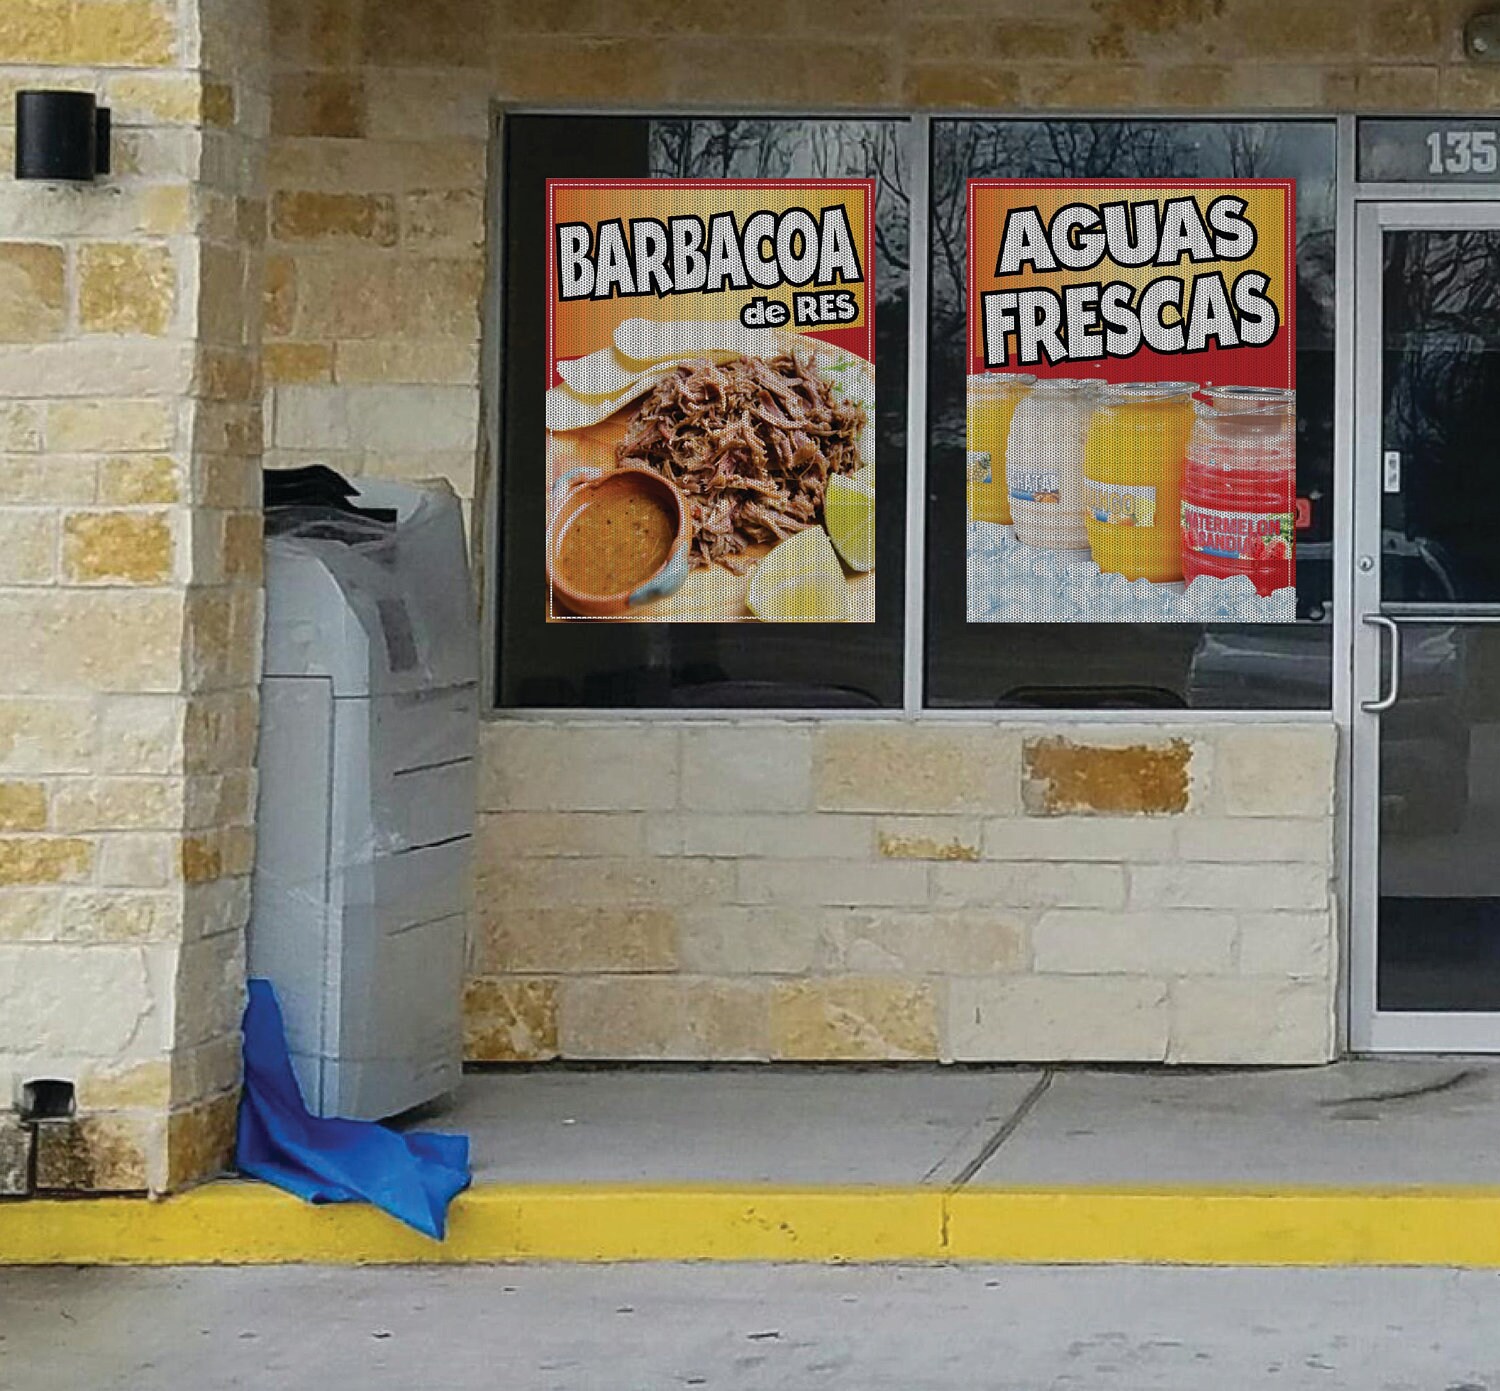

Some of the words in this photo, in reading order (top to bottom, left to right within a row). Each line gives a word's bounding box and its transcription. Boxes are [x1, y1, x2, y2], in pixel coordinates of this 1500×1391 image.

[557, 205, 863, 300] BARBACOA
[996, 196, 1257, 275] AGUAS
[742, 300, 788, 328] de
[795, 292, 858, 326] RES
[982, 271, 1278, 367] FRESCAS
